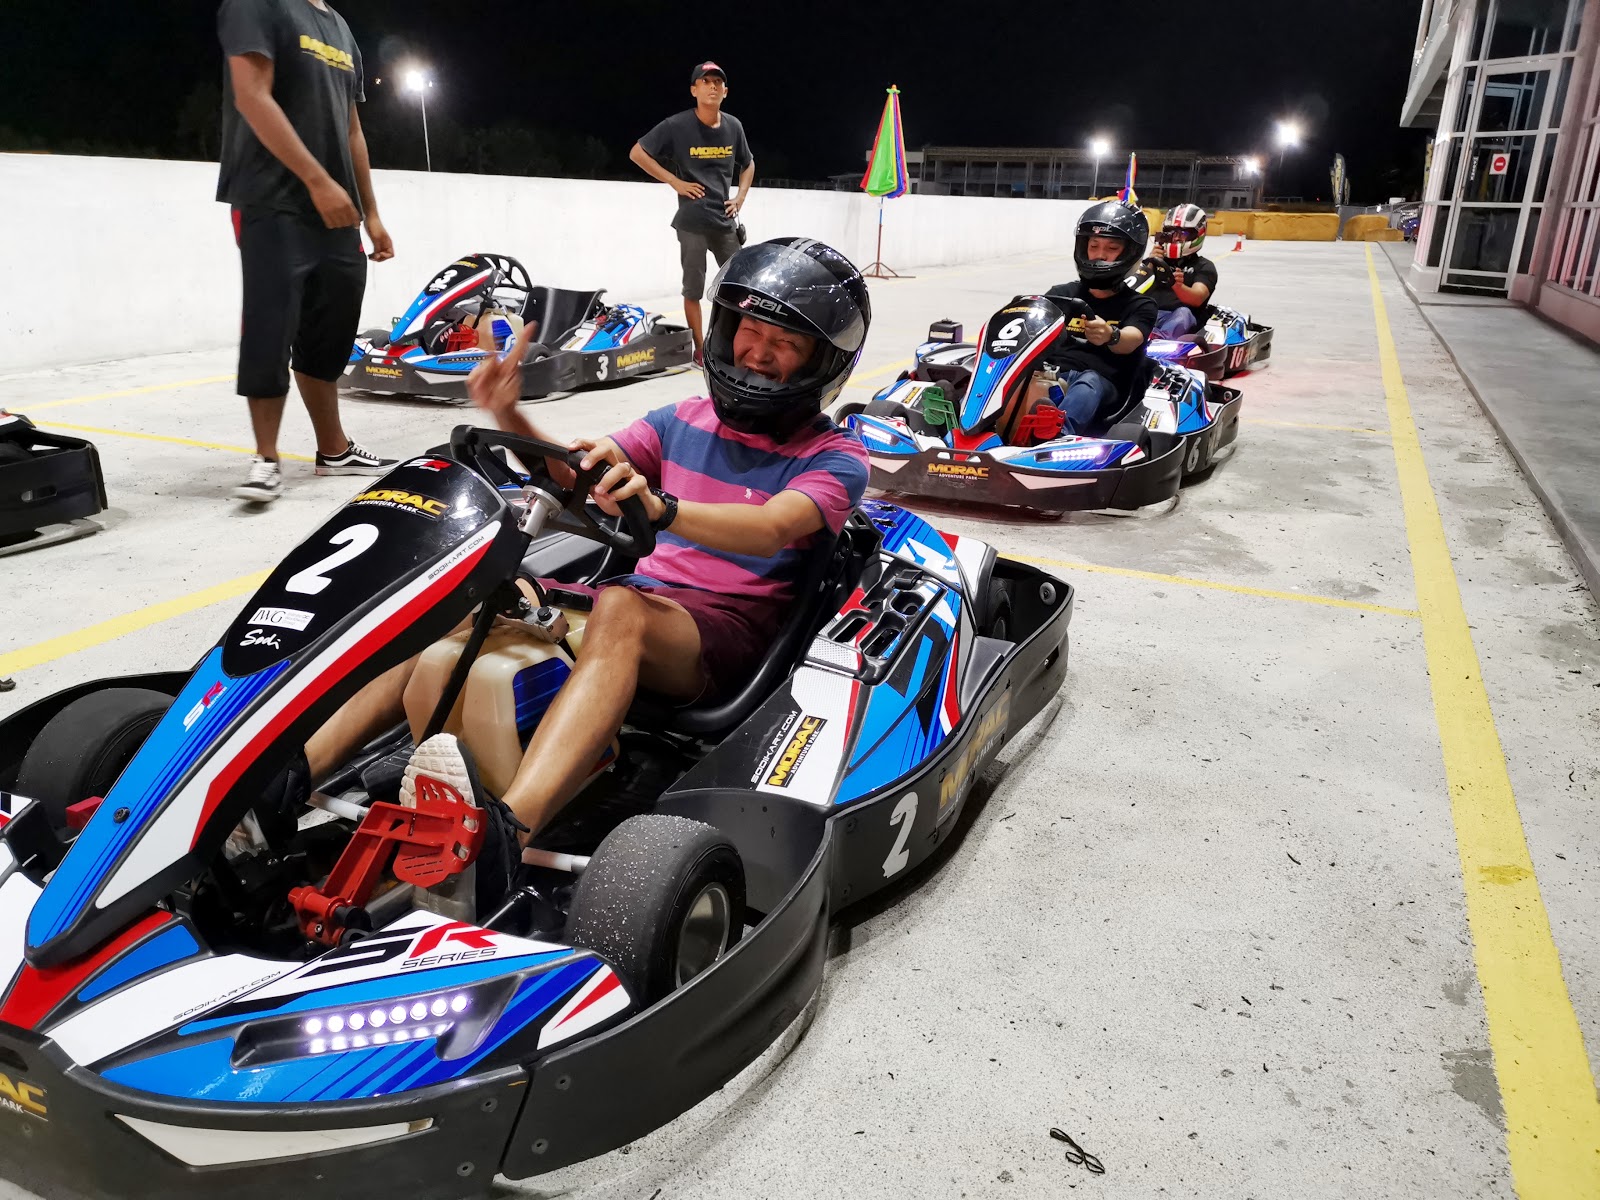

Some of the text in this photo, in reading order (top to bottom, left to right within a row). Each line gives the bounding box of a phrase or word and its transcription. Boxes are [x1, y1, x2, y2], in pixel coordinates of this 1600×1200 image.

[689, 145, 733, 156] MORAC
[997, 318, 1026, 340] 6
[596, 355, 609, 380] 3
[616, 348, 655, 368] MORAC
[1229, 346, 1244, 369] 10
[365, 366, 403, 377] MORAC
[1187, 436, 1201, 473] 6
[927, 463, 989, 477] MORAC
[352, 490, 448, 516] MORAC
[397, 504, 419, 513] PARK
[285, 523, 379, 595] 2
[750, 710, 798, 784] SODIKART.COM
[768, 717, 821, 786] MORAC
[882, 791, 919, 878] 2
[400, 947, 499, 970] SERIES
[172, 971, 281, 1021] SODIKART.COM
